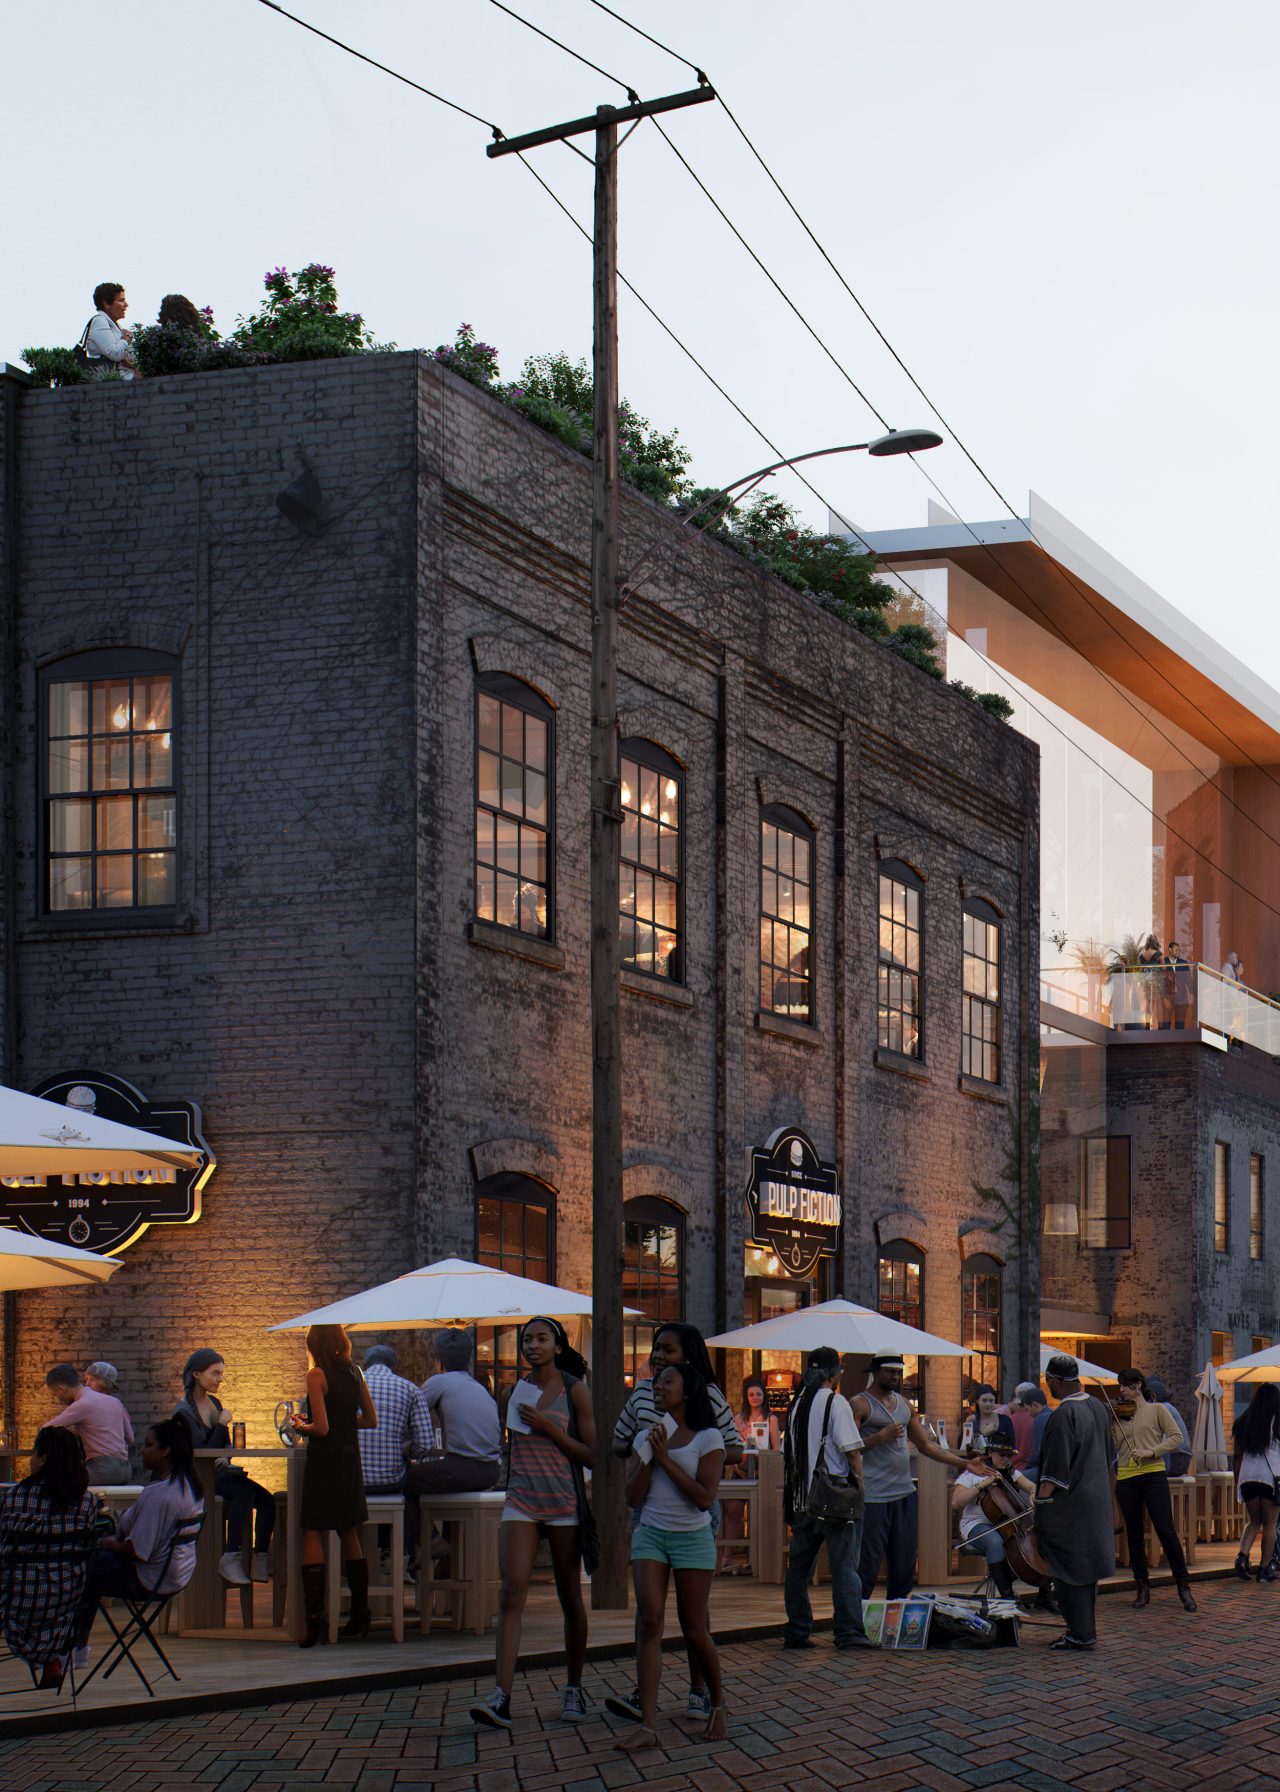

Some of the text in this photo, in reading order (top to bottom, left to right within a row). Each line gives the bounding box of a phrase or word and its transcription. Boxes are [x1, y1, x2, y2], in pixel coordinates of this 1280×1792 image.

[68, 1198, 90, 1209] 1994
[768, 1181, 841, 1227] PULP FICTION
